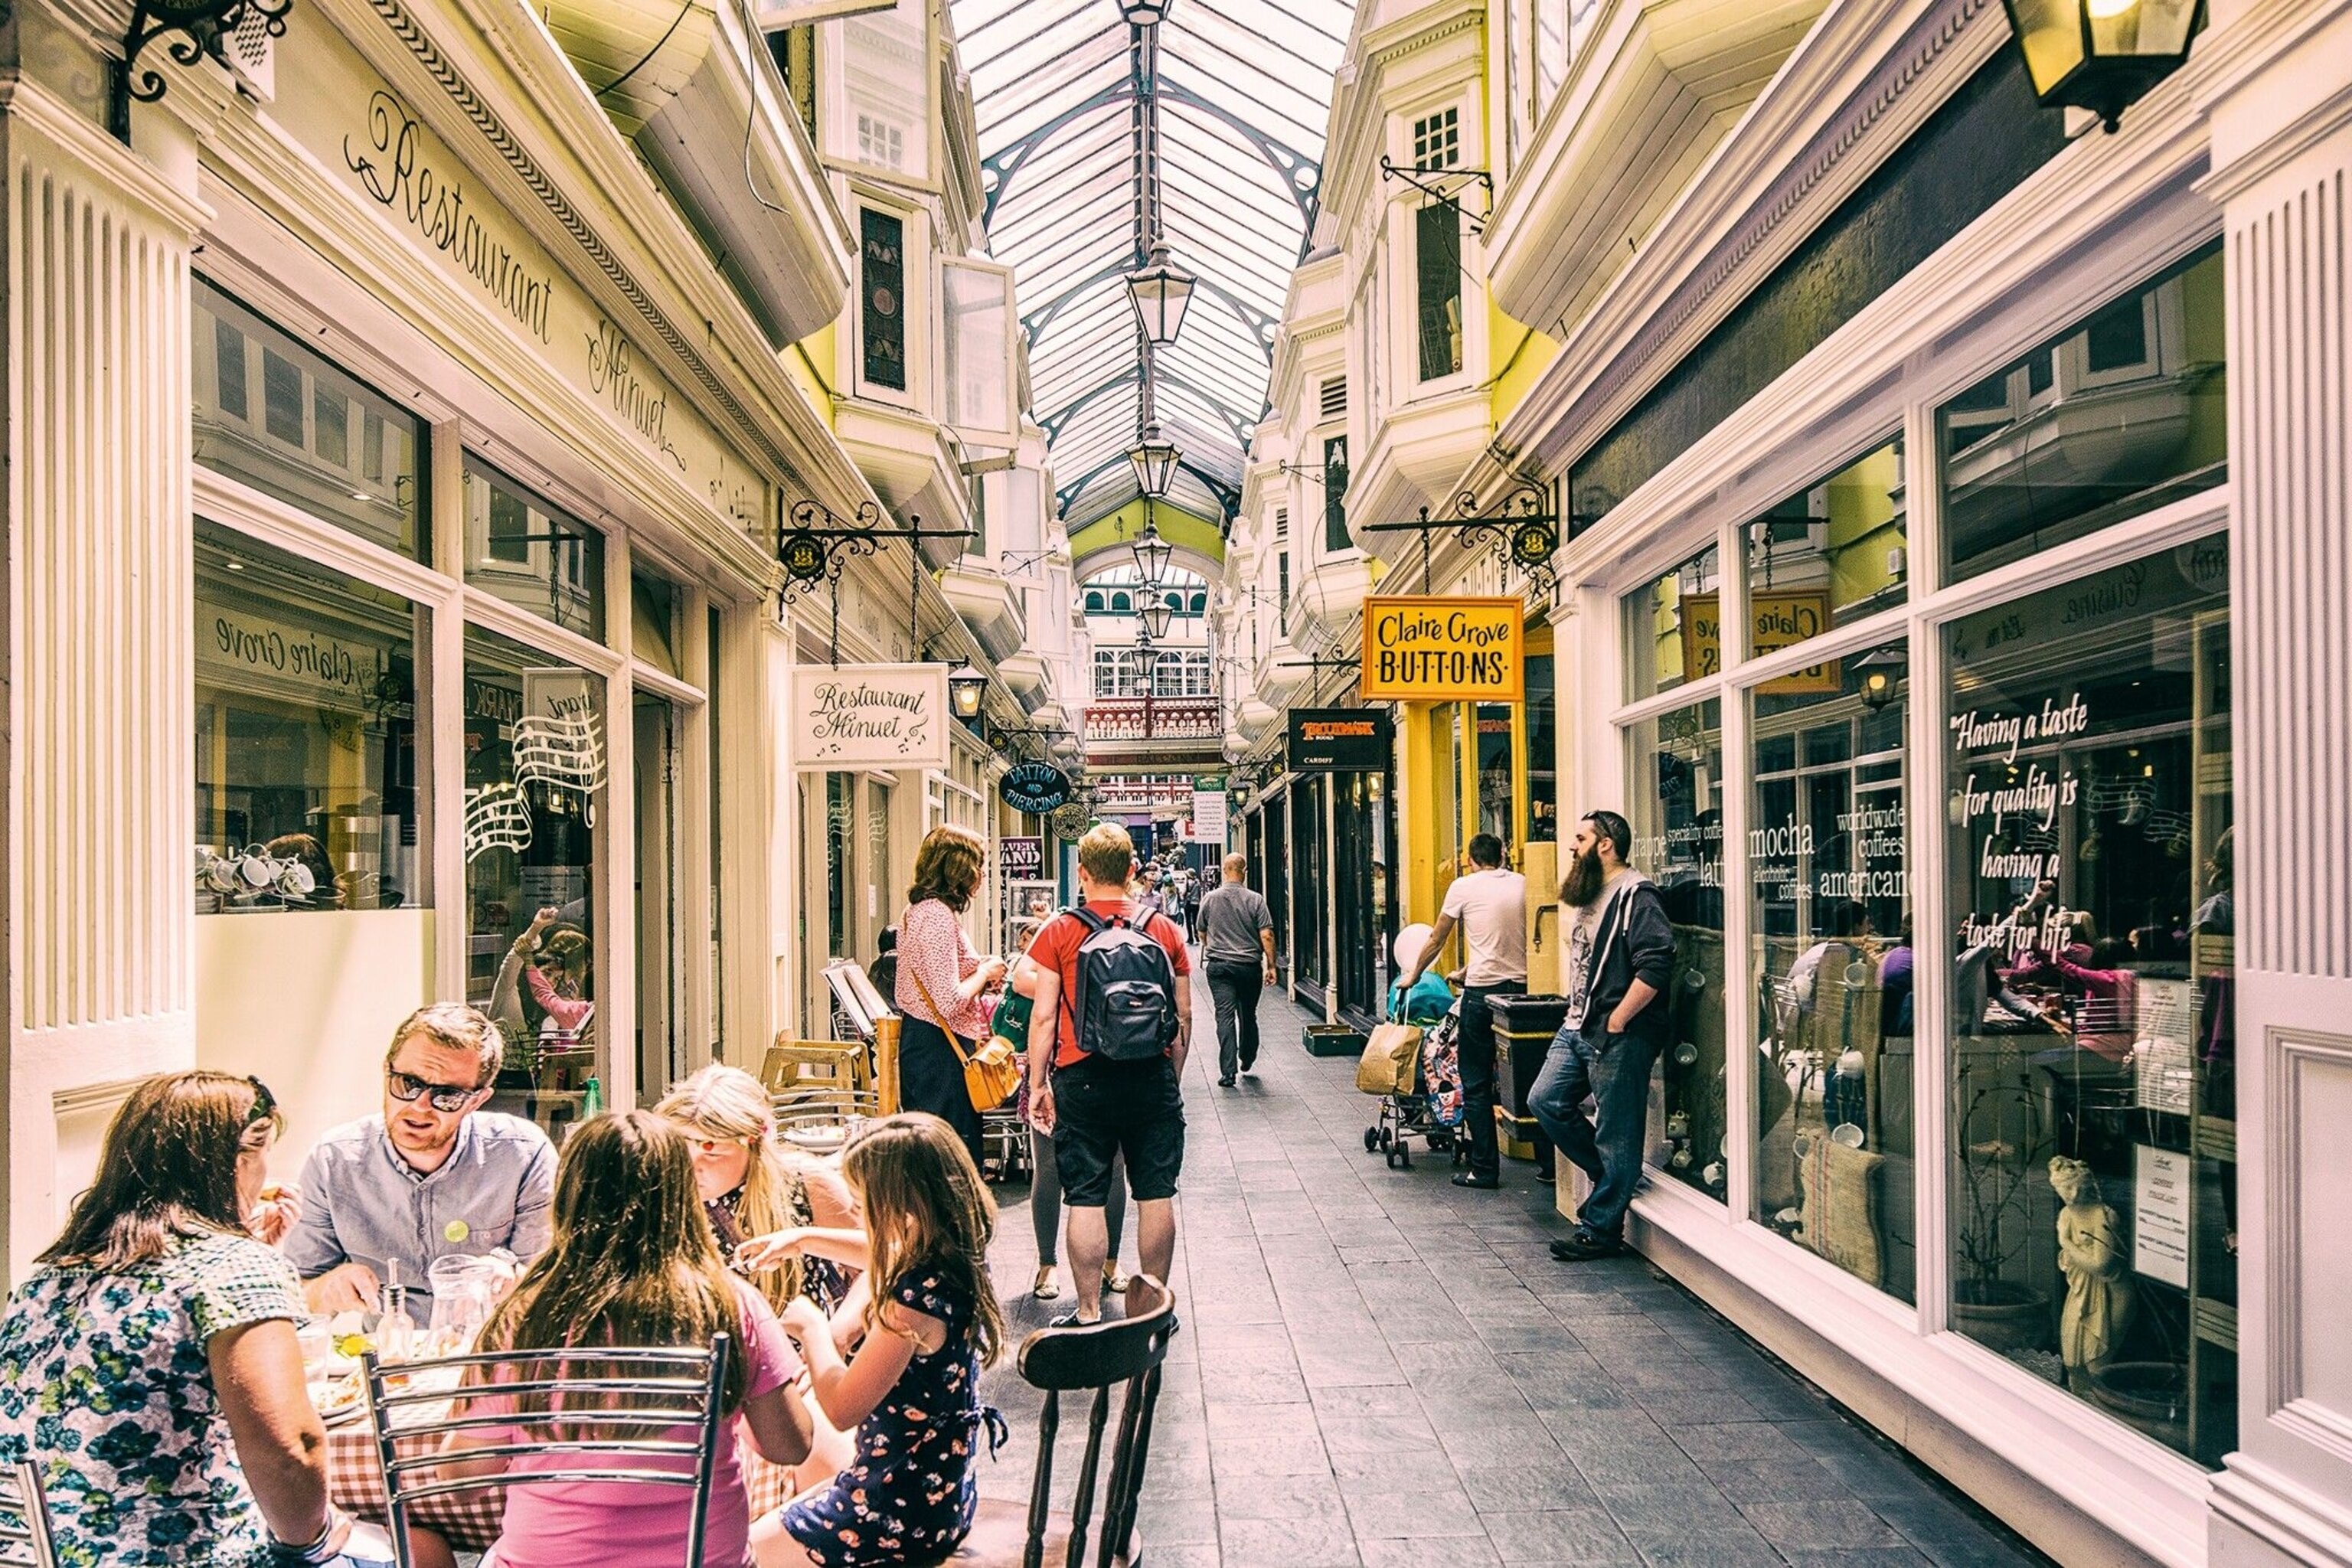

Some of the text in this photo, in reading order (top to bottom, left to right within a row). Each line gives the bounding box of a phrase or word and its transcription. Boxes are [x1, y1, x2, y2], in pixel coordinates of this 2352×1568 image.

[344, 90, 677, 463] Restaurant Minuet
[1378, 612, 1509, 647] Claire Grove
[810, 681, 926, 717] Restaurant
[813, 712, 902, 739] Minuet
[2023, 717, 2037, 738] a
[2040, 692, 2089, 737] taste
[1006, 764, 1057, 785] TATTOO
[1006, 789, 1063, 812] PIERCING
[1963, 764, 2078, 835] for quality is
[1836, 800, 1906, 831] worldwide
[1668, 823, 1703, 847] speciality
[1749, 812, 1815, 858] mocha
[1858, 830, 1906, 858] coffees
[1013, 864, 1039, 872] specialist
[1753, 864, 1790, 884] alcoholic
[1981, 835, 2060, 907] having a
[1779, 877, 1813, 900] coffees
[1965, 912, 2007, 952] taste
[2006, 913, 2037, 963] for
